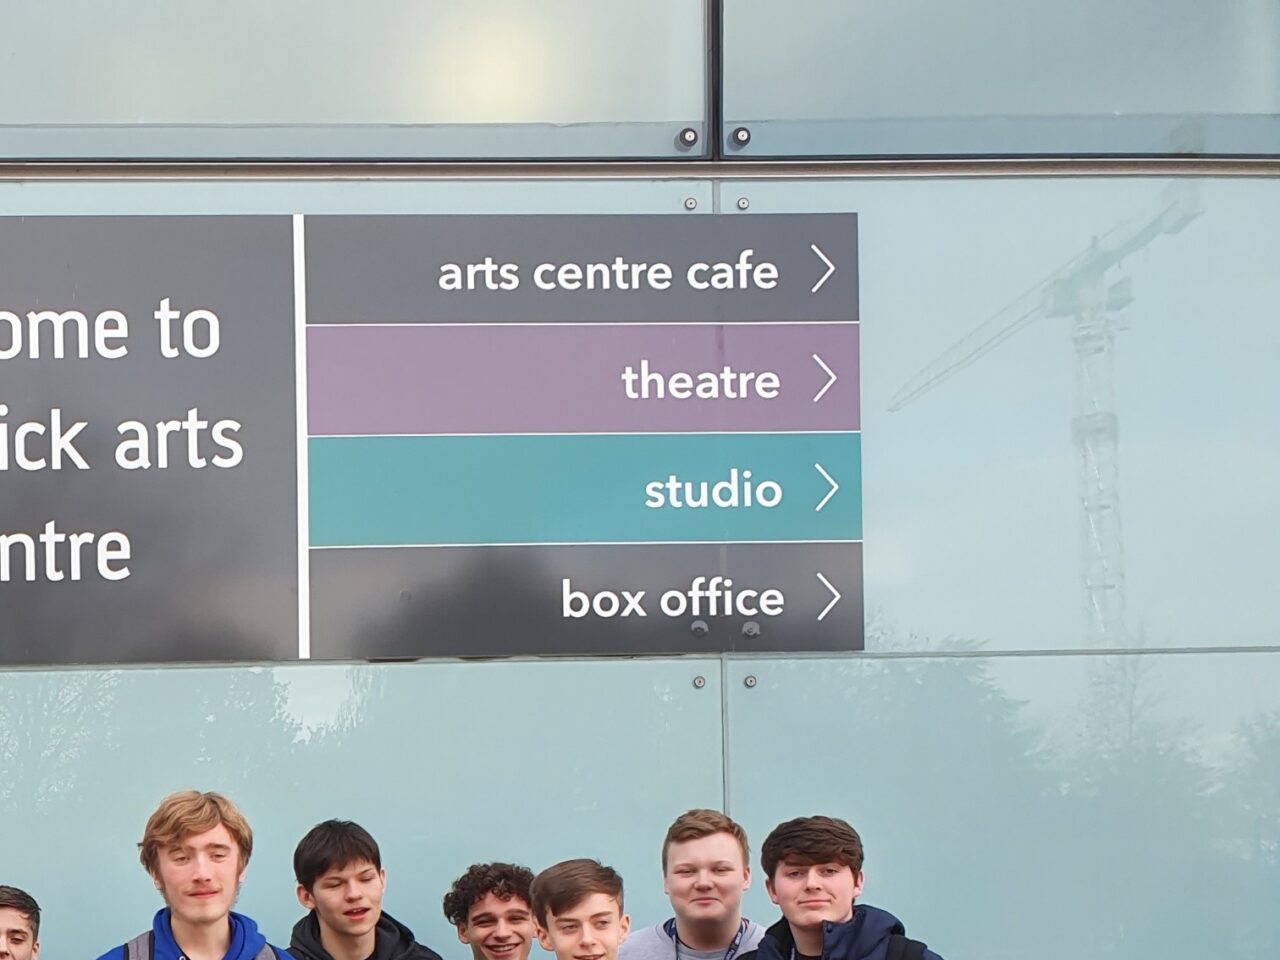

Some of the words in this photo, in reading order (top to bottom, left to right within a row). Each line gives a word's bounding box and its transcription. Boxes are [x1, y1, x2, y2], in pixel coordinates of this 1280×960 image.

[438, 258, 520, 290] arts
[533, 257, 673, 290] centre
[687, 250, 779, 290] cafe
[154, 298, 220, 358] to
[621, 360, 780, 399] theatre
[115, 408, 243, 470] arts
[645, 469, 783, 508] studio
[562, 579, 647, 618] box
[660, 577, 785, 617] office
